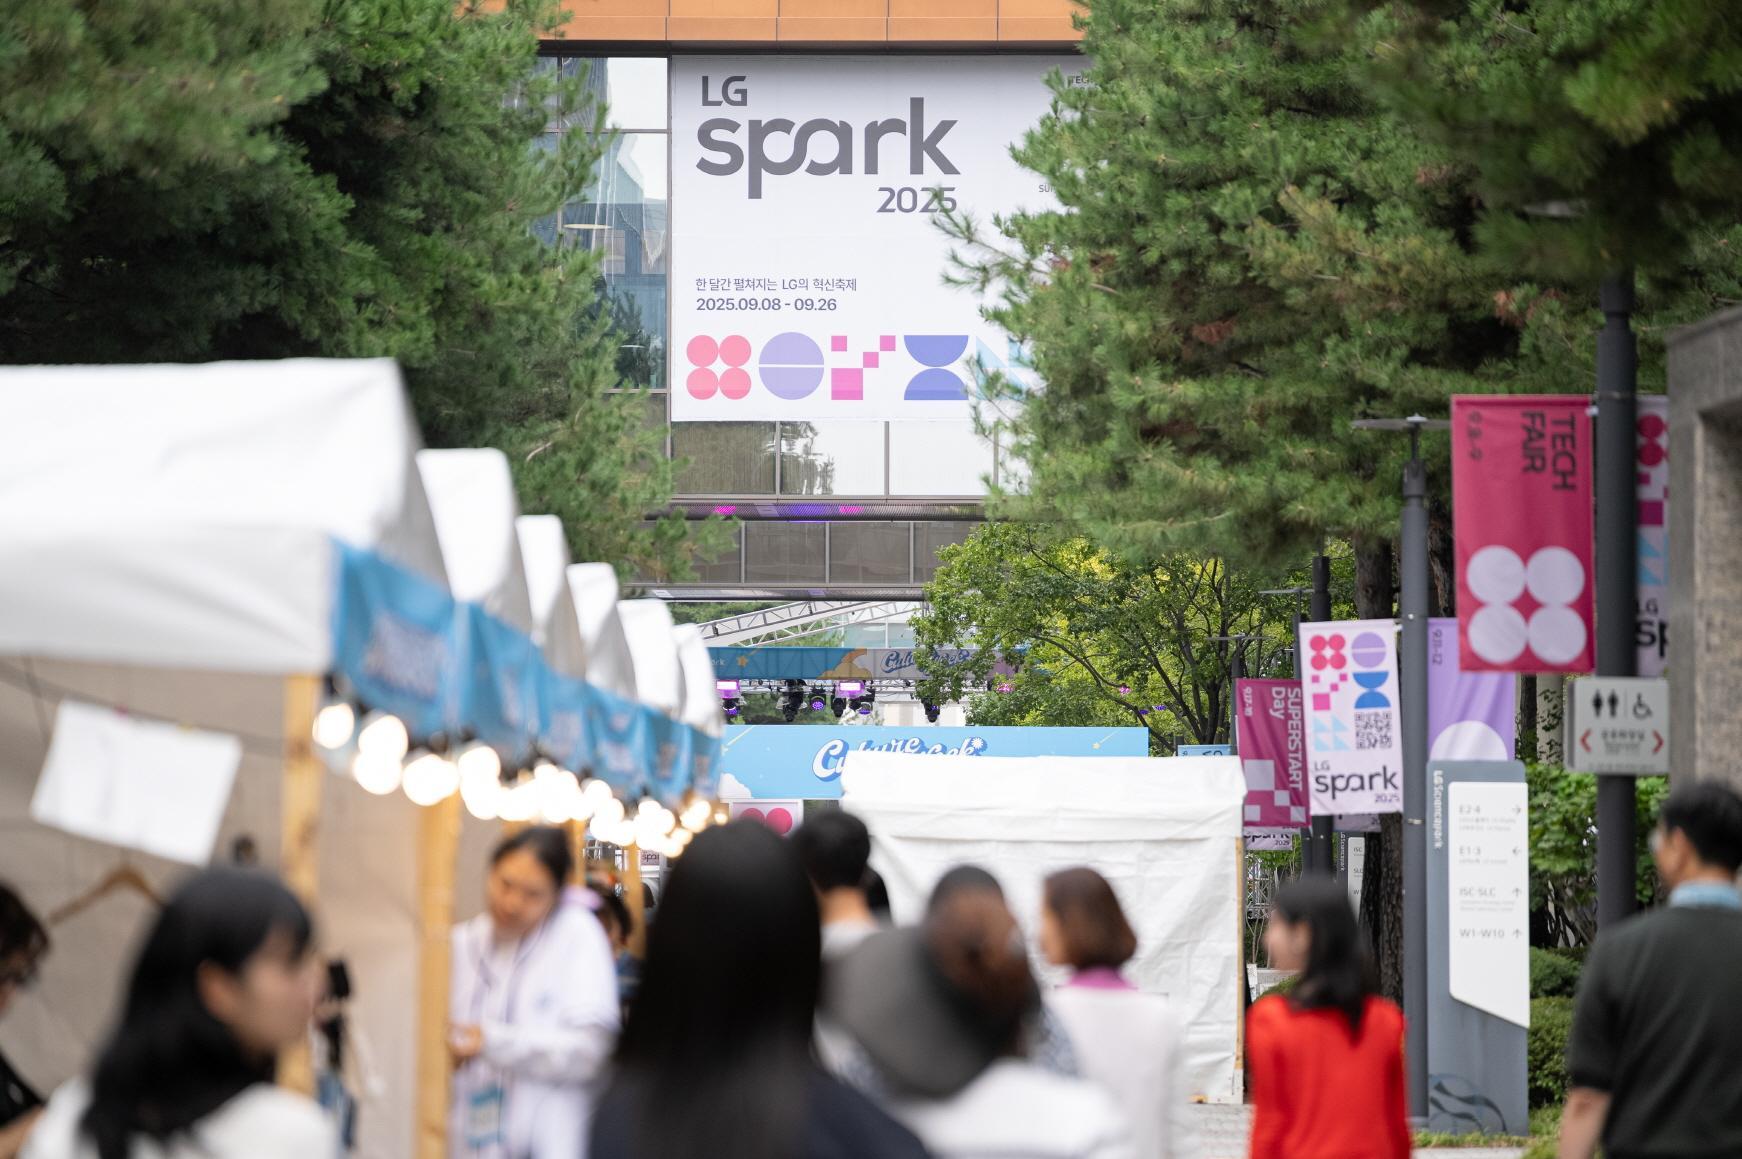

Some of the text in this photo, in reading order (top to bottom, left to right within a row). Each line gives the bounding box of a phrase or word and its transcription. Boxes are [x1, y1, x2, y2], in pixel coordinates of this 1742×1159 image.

[702, 76, 748, 107] LG
[696, 97, 961, 199] spark
[877, 187, 957, 213] 2025
[696, 278, 857, 292] 한 달간 펼쳐지는 LG의 혁신축제
[696, 298, 781, 311] 2025.09.08
[794, 298, 837, 311] 09.26
[1521, 411, 1546, 473] FAIR
[1552, 411, 1577, 491] TECH
[1269, 687, 1286, 720] Day
[1287, 687, 1303, 791] SUPERSTART
[1315, 760, 1330, 771] LG
[1315, 765, 1398, 800] spark
